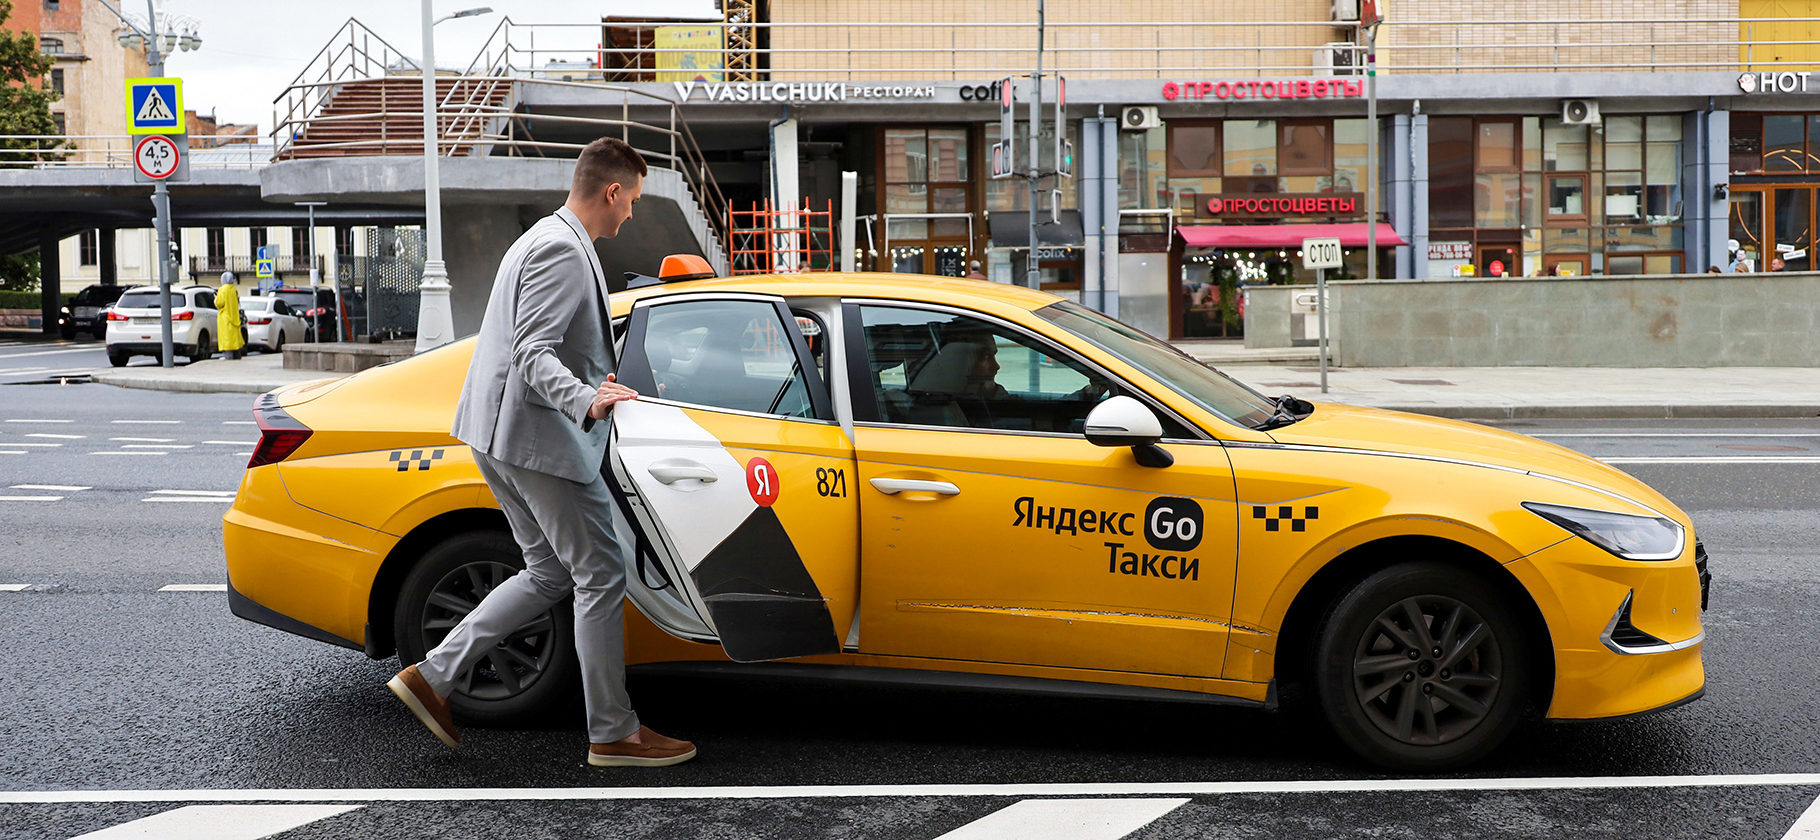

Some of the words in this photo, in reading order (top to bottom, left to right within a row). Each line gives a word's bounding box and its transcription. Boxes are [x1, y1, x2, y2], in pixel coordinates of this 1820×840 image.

[704, 82, 846, 102] VASILCHUKI
[853, 86, 935, 98] РЕСТОРАН
[1760, 71, 1812, 93] HOT
[145, 145, 169, 159] 4,5
[1223, 197, 1355, 214] ПРОСТОЦВЕТЫ
[1309, 243, 1338, 263] СТОП
[753, 464, 771, 496] Я
[815, 467, 847, 498] 821
[1012, 496, 1136, 536] Яндекс
[1150, 506, 1197, 541] Go
[1104, 541, 1200, 581] Такси
